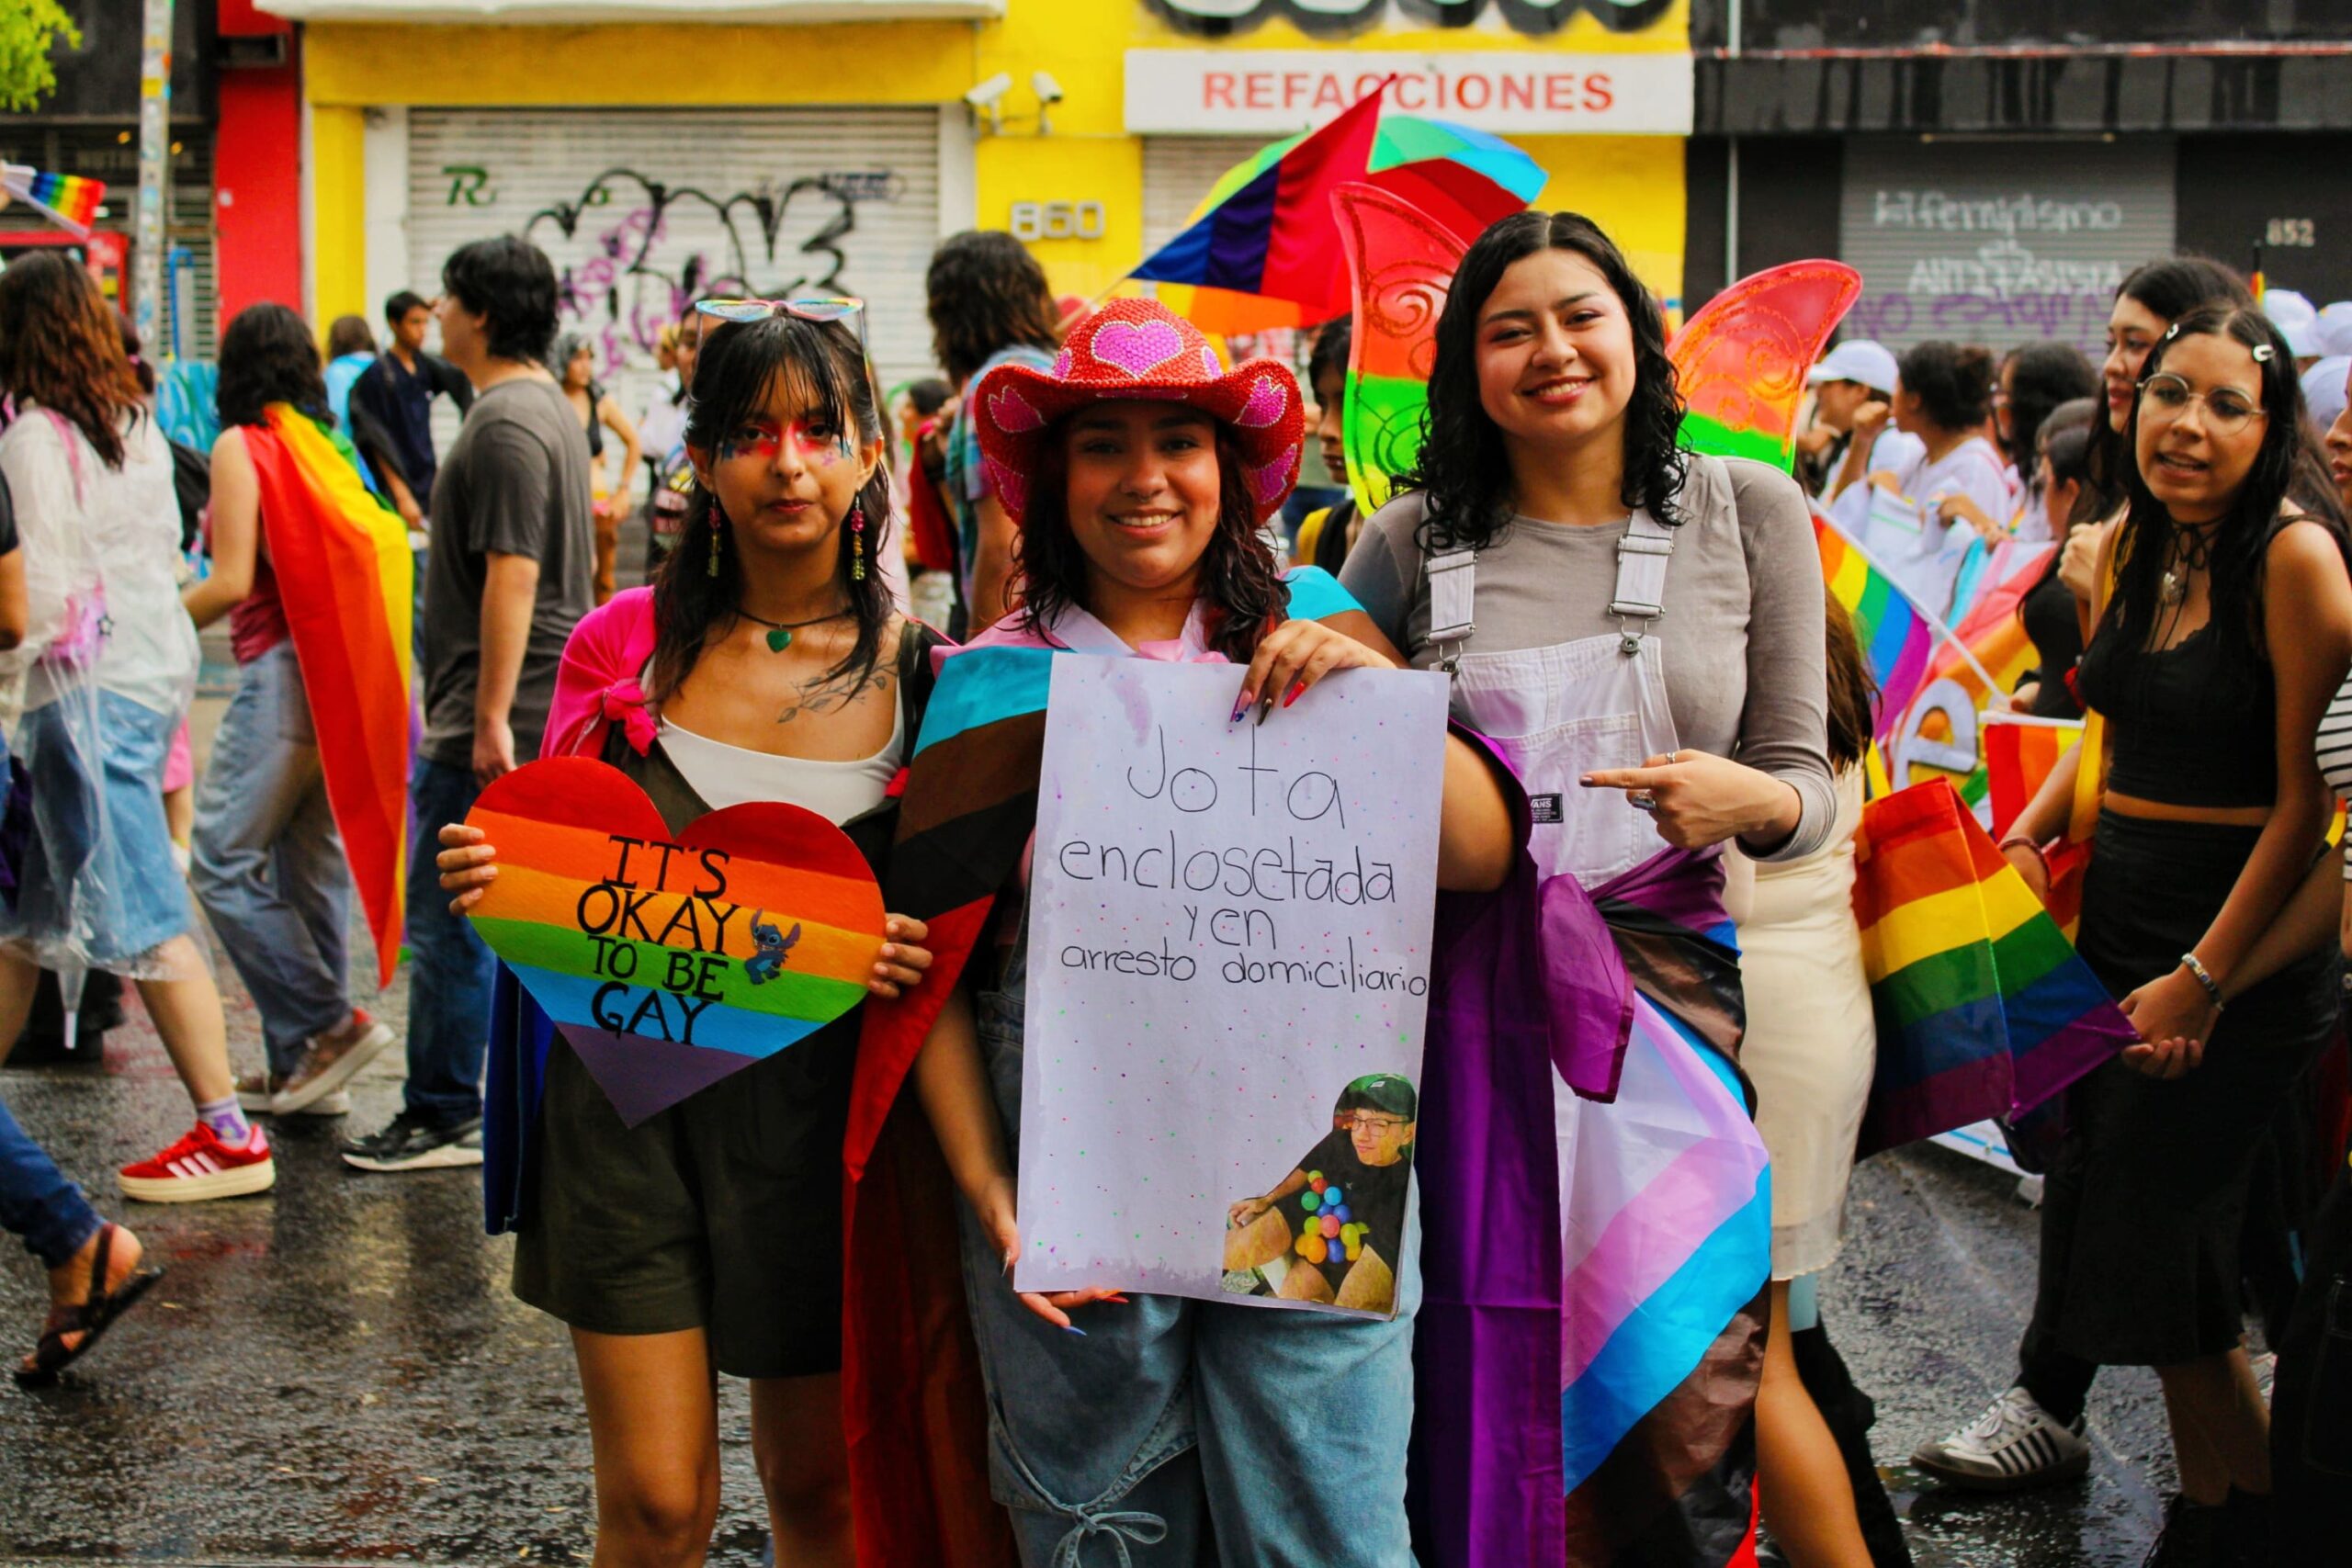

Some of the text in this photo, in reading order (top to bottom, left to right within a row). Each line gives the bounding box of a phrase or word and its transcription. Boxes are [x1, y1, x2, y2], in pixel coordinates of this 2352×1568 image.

[1202, 72, 1616, 113] REFACCIONES
[1012, 199, 1105, 243] 860
[2266, 218, 2315, 247] 852
[602, 834, 730, 901] IT'S
[1059, 829, 1396, 907] enclosetada
[577, 884, 741, 957] OKAY
[587, 934, 729, 1002] TO BE
[1060, 935, 1429, 998] arresto domiciliario
[591, 980, 715, 1047] GAY
